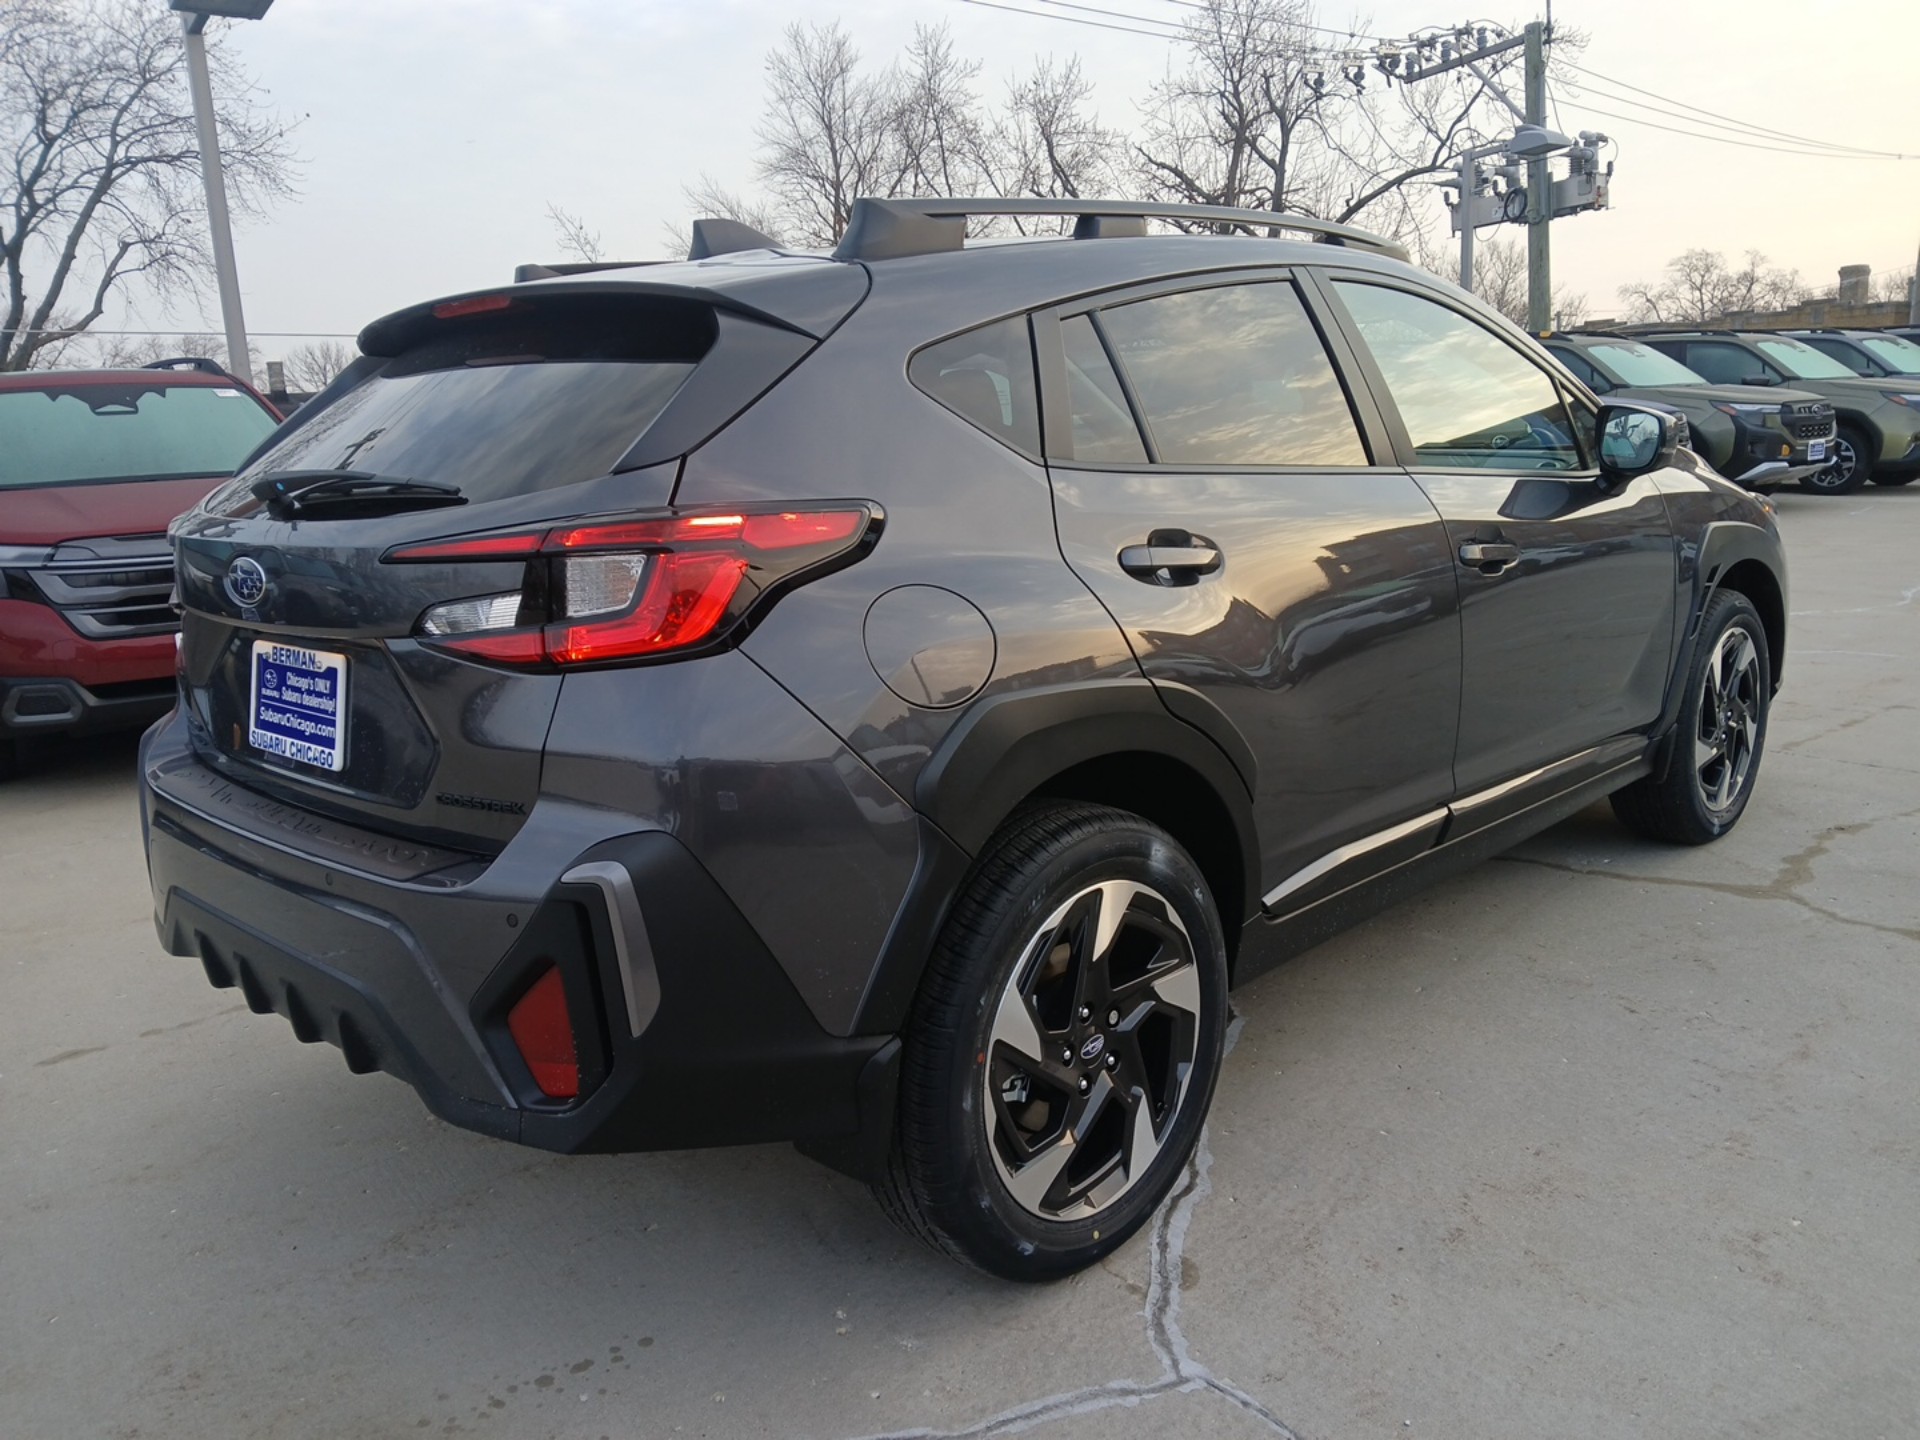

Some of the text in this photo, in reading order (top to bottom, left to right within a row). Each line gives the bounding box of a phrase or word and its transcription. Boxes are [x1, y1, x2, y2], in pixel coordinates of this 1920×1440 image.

[272, 646, 316, 669] BERMAN
[286, 672, 331, 694] Chicago's ONLY
[281, 687, 302, 704] Subaru
[260, 706, 336, 739] SubaruChicago.com
[251, 730, 334, 769] SUBARU CHICAGO
